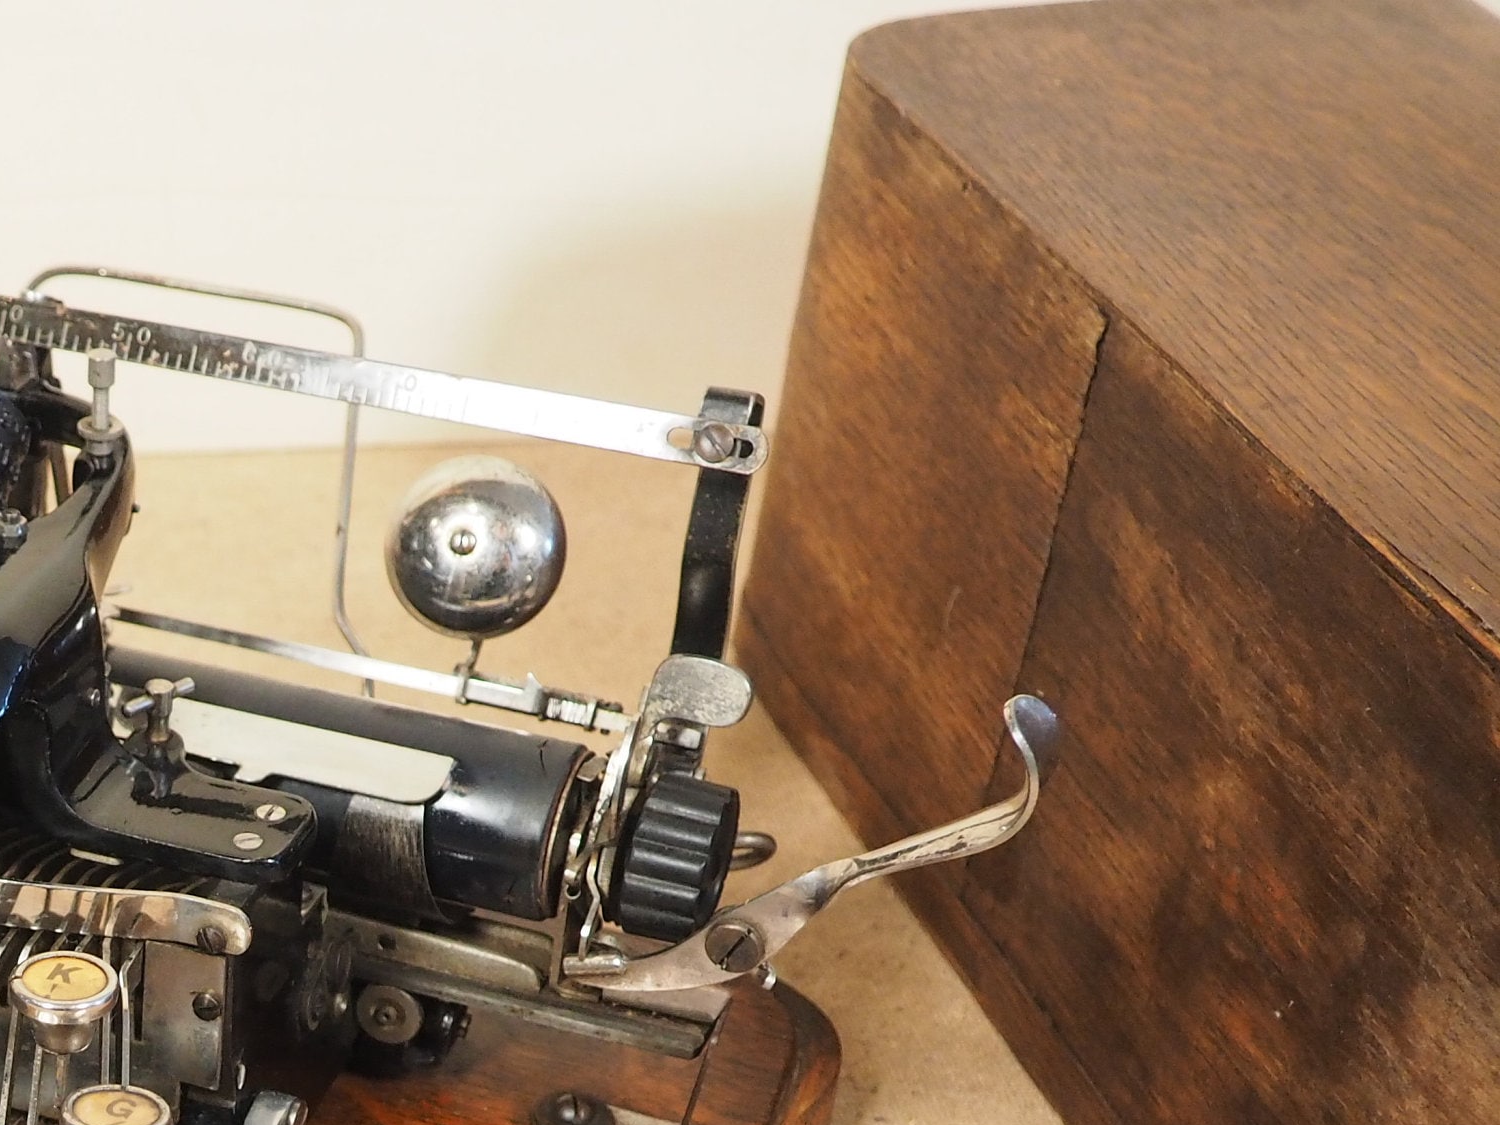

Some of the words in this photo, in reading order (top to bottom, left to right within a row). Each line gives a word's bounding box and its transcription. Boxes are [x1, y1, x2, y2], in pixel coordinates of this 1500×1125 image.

[111, 321, 151, 345] 50
[46, 963, 83, 984] K
[106, 1100, 136, 1120] G
